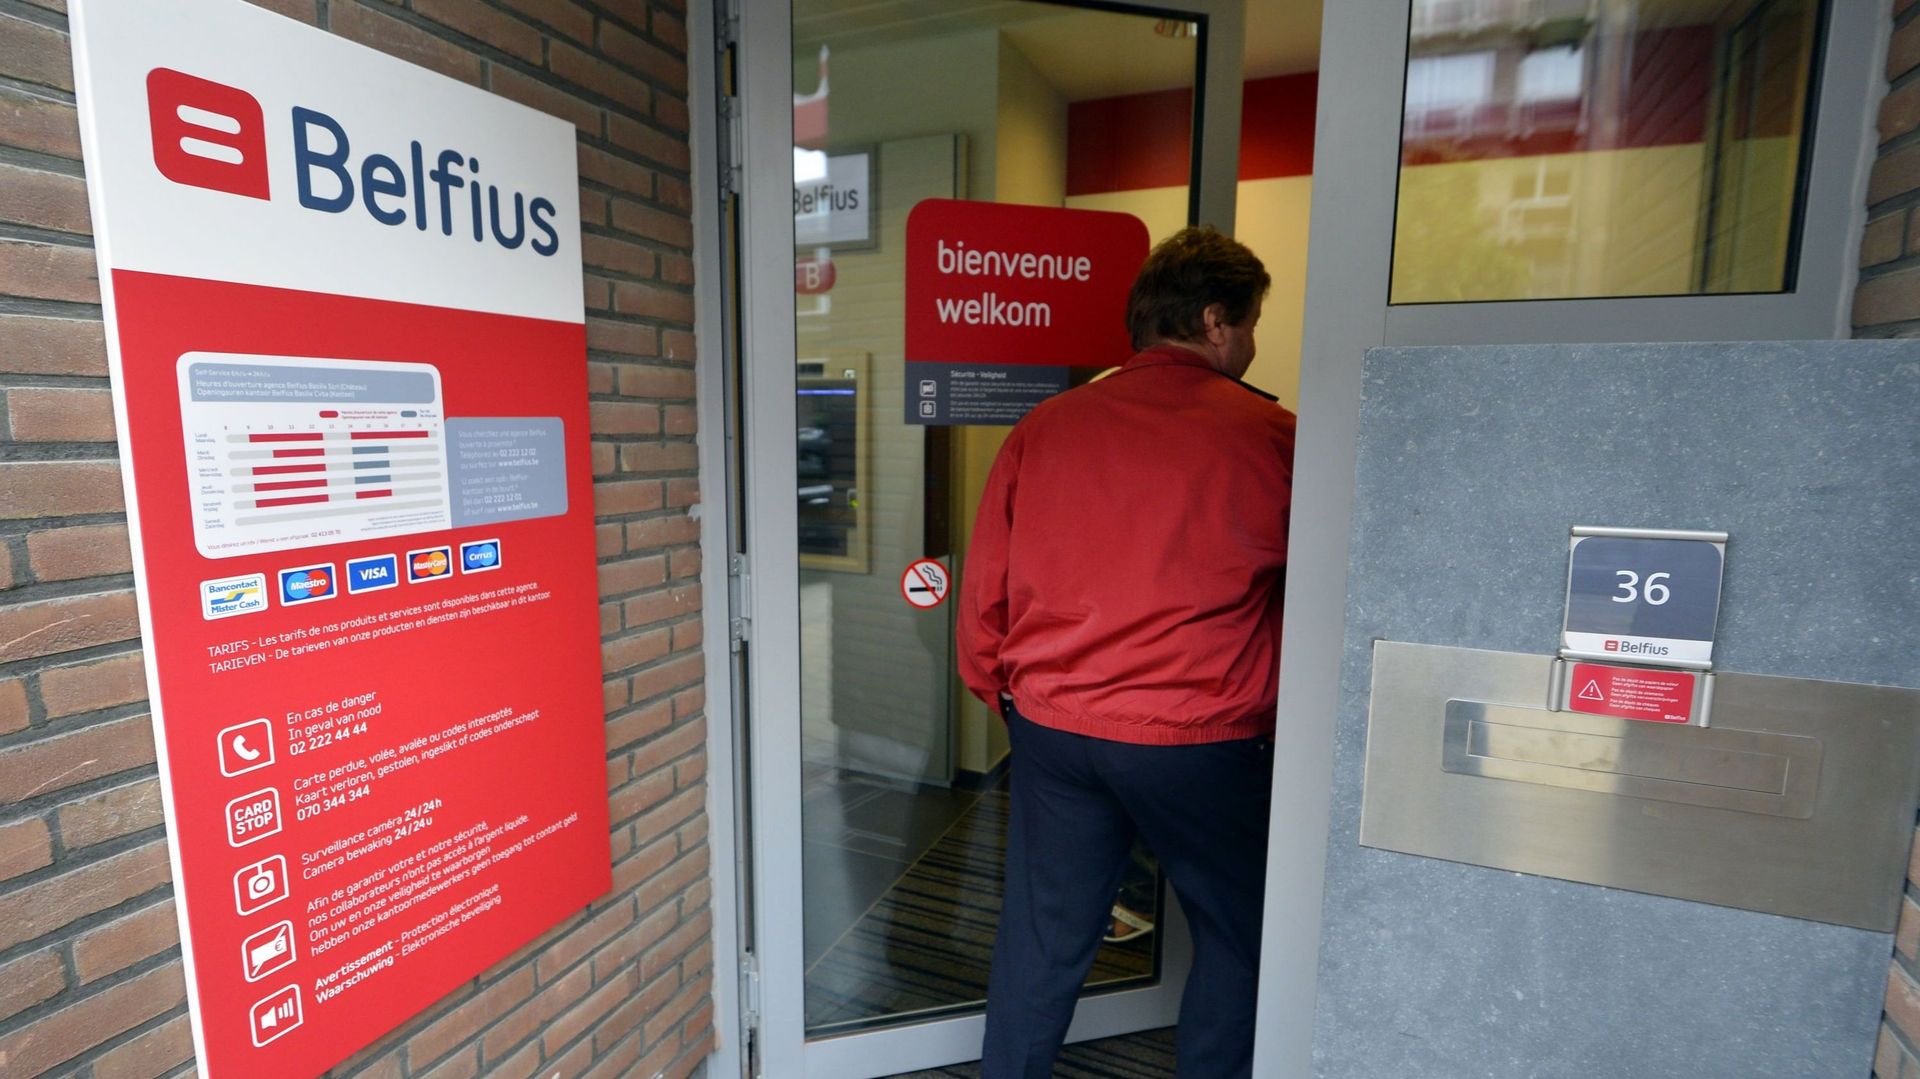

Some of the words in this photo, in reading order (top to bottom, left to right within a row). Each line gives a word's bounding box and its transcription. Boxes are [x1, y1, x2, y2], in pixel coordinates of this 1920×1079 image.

[292, 105, 560, 257] Belfius
[938, 239, 1091, 281] bienvenue
[936, 291, 1051, 327] welkom
[359, 567, 388, 580] VISA
[413, 559, 447, 570] MasterCard
[469, 551, 493, 561] Cirrus
[209, 580, 258, 593] Bancontact
[290, 578, 326, 591] Maestro
[1612, 570, 1671, 605] 36
[208, 640, 249, 657] TARIFS
[259, 636, 277, 647] Les
[279, 629, 307, 643] tarifs
[309, 626, 321, 636] de
[323, 623, 339, 633] nos
[340, 615, 377, 631] produits
[378, 612, 387, 621] et
[389, 606, 422, 620] services
[423, 602, 440, 612] sont
[442, 594, 480, 608] disponibles
[480, 590, 496, 600] dans
[497, 587, 515, 597] cette
[211, 604, 236, 614] Mister
[239, 600, 260, 609] Cash
[209, 653, 266, 674] TARIEVEN
[275, 649, 289, 659] De
[291, 639, 331, 655] tarieven
[332, 636, 349, 646] van
[350, 631, 371, 642] onze
[372, 622, 414, 639] producten
[416, 619, 426, 628] en
[427, 611, 458, 625] diensten
[459, 608, 471, 619] zijn
[473, 600, 511, 616] beschikbaar
[511, 597, 517, 606] in
[518, 595, 527, 605] dit
[1620, 641, 1669, 656] Belfius
[287, 712, 302, 724] En
[304, 707, 323, 719] cas
[326, 702, 339, 713] de
[342, 692, 376, 708] danger
[288, 728, 302, 741] In
[305, 717, 334, 737] geval
[336, 713, 354, 725] van
[357, 702, 381, 719] nood
[289, 741, 306, 755] 02
[309, 733, 332, 750] 222
[335, 727, 350, 740] 44
[353, 722, 367, 735] 44
[293, 772, 326, 790] Carte
[329, 759, 367, 781] perdue,
[369, 748, 397, 764] volée,
[399, 737, 428, 754] avalée
[429, 732, 441, 743] ou
[442, 723, 467, 739] codes
[468, 707, 513, 730] interceptés
[295, 787, 328, 806] Kaart
[330, 771, 375, 793] verloren,
[377, 755, 420, 779] gestolen,
[421, 740, 457, 760] ingeslikt
[459, 734, 468, 746] of
[469, 727, 493, 742] codes
[493, 709, 540, 733] onderschept
[234, 799, 272, 821] CARD
[297, 803, 321, 821] 070
[323, 794, 345, 811] 344
[349, 785, 370, 801] 344
[236, 812, 273, 835] STOP
[301, 832, 365, 865] Surveillance
[367, 816, 402, 838] caméra
[302, 856, 344, 880] Camera
[346, 835, 393, 861] bewaking
[307, 896, 329, 913] Afin
[331, 890, 344, 902] de
[346, 869, 386, 896] garantir
[388, 856, 414, 874] votre
[415, 850, 426, 861] et
[427, 838, 453, 855] notre
[453, 821, 489, 843] sécurité,
[308, 912, 328, 928] nos
[330, 877, 400, 917] collaborateurs
[402, 864, 425, 882] n'ont
[426, 856, 442, 871] pas
[443, 844, 467, 862] accès
[468, 840, 473, 849] à
[474, 825, 504, 846] l'argent
[309, 926, 329, 942] Om
[330, 918, 347, 932] uw
[349, 911, 361, 922] en
[363, 898, 386, 915] onze
[388, 875, 430, 902] veiligheid
[431, 870, 442, 880] te
[442, 846, 491, 875] waarborgen
[311, 931, 350, 957] hebben
[352, 918, 376, 935] onze
[377, 868, 471, 923] kantoormedewerkers
[471, 859, 491, 876] geen
[492, 842, 523, 863] toegang
[523, 835, 535, 847] tot
[536, 821, 563, 840] contant
[563, 812, 578, 827] geld
[315, 940, 395, 991] Avertissement
[401, 912, 448, 943] Protection
[449, 883, 500, 915] électronique
[315, 955, 394, 1004] Waarschuwing
[401, 919, 460, 956] Elektronische
[461, 894, 502, 922] beveiliging
